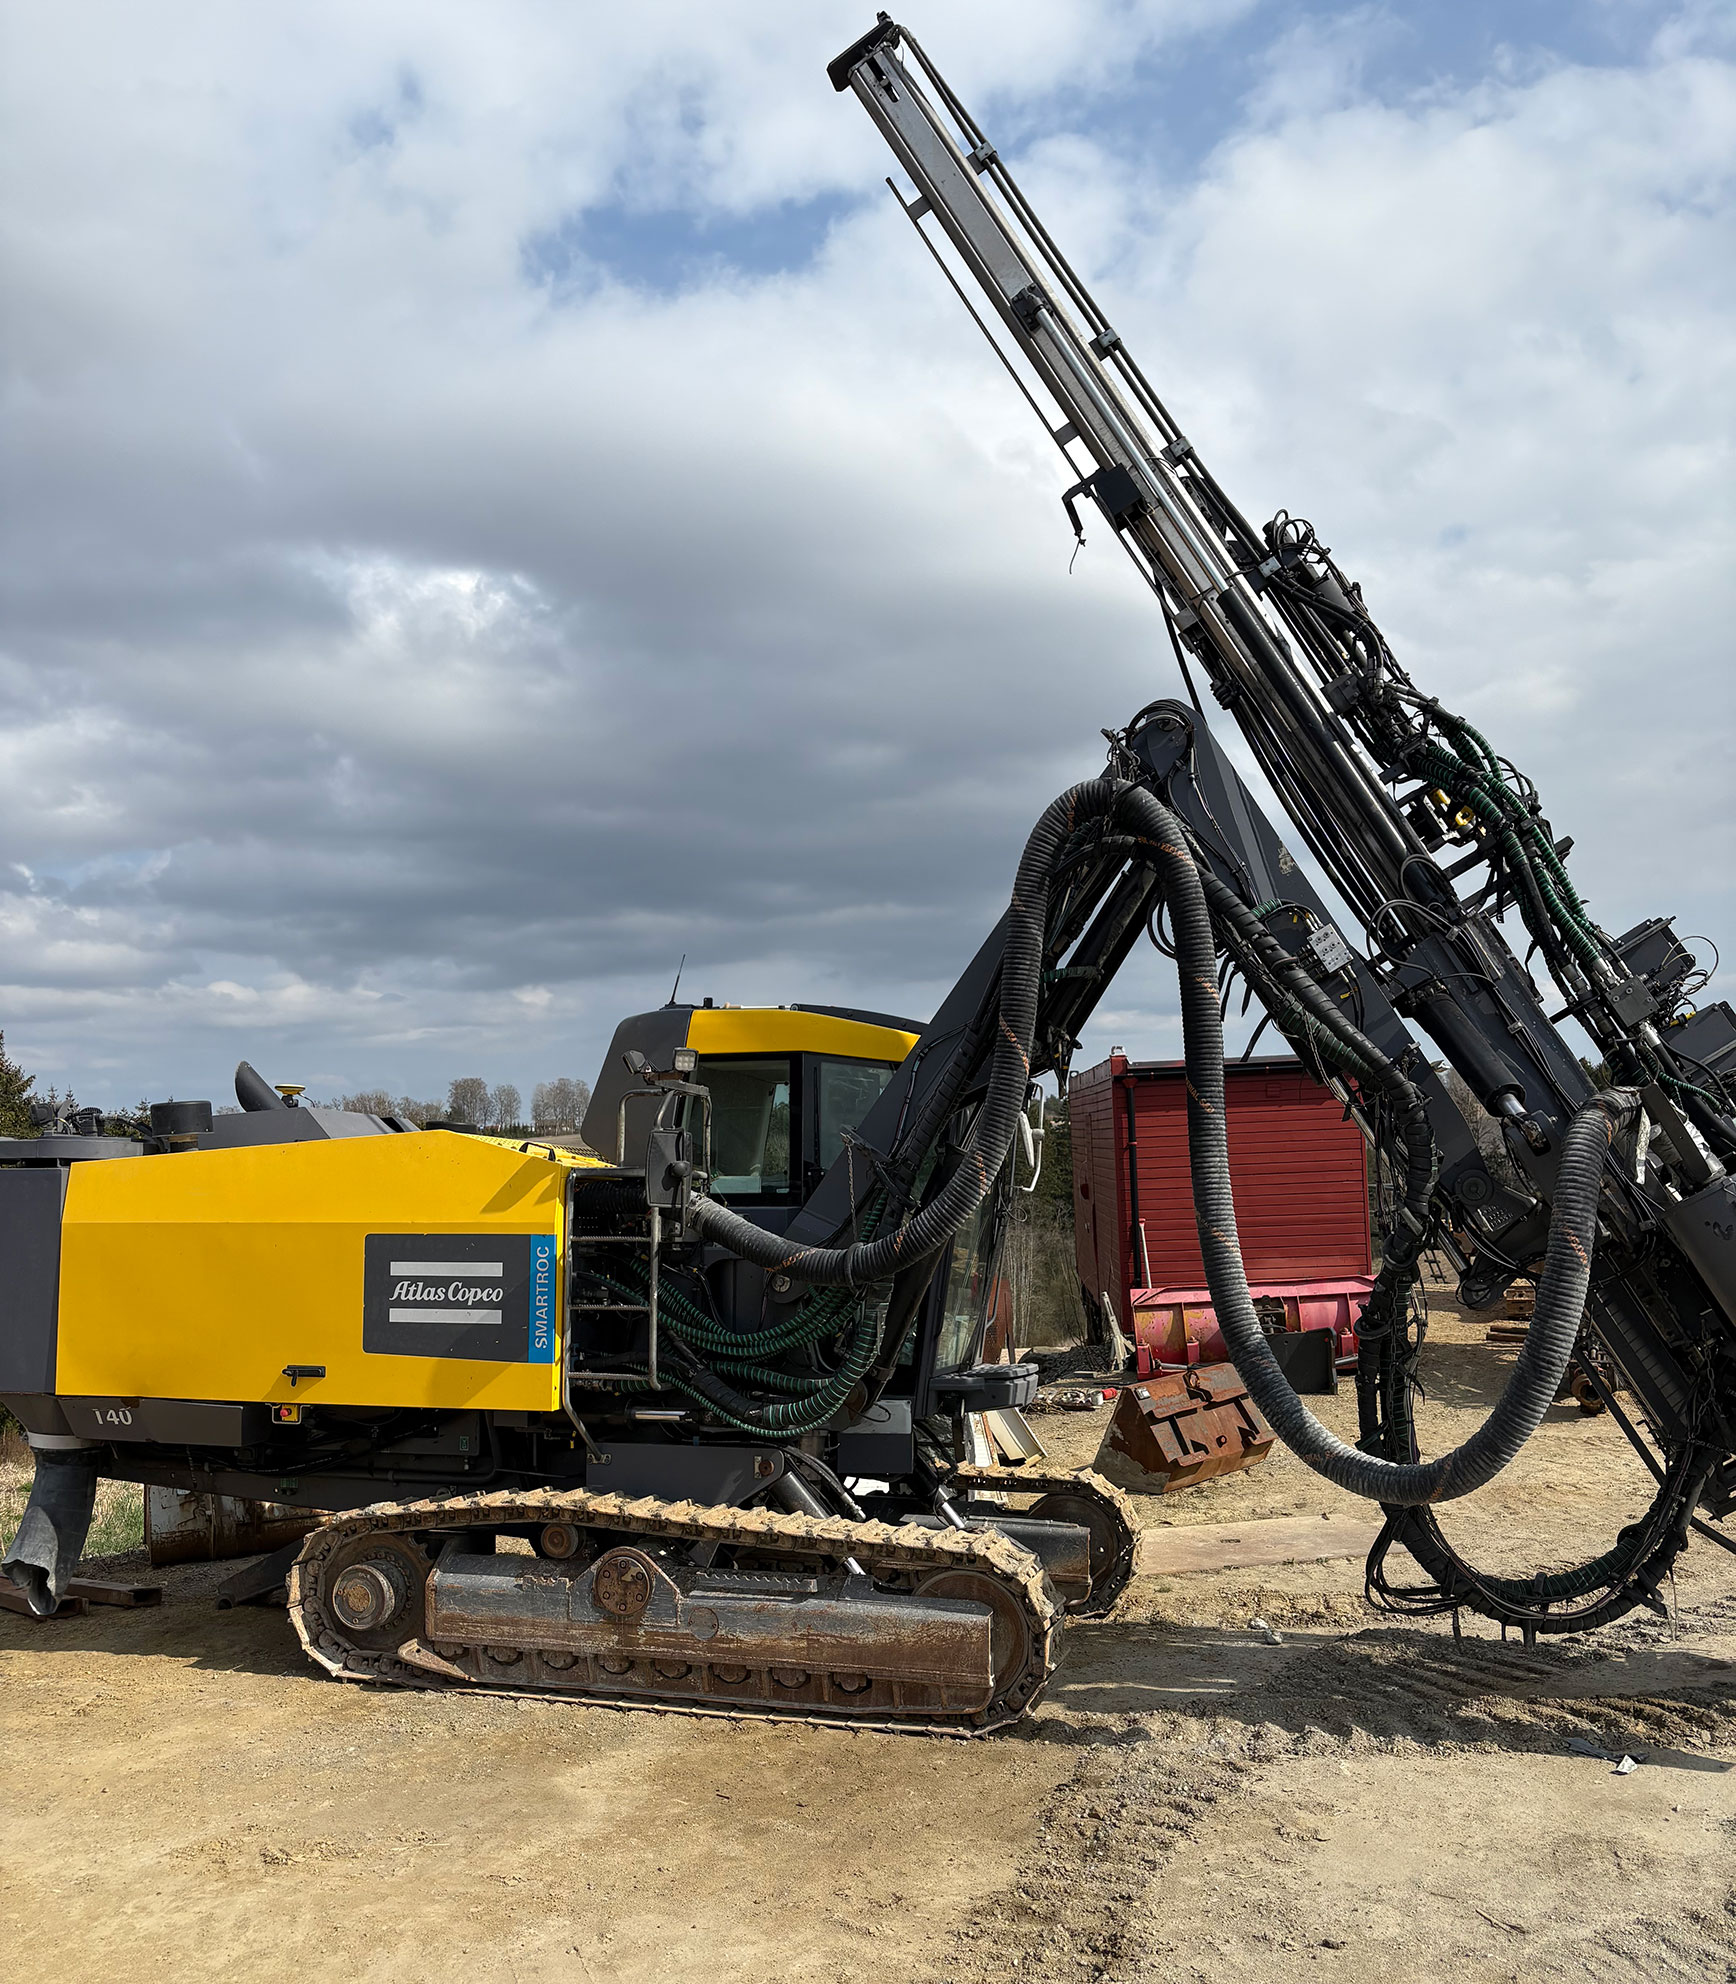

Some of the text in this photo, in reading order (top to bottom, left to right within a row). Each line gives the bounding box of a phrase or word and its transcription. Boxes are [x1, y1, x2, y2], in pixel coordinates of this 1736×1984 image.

[389, 1280, 504, 1306] Atlas Copco
[534, 1245, 550, 1349] SMARTROC
